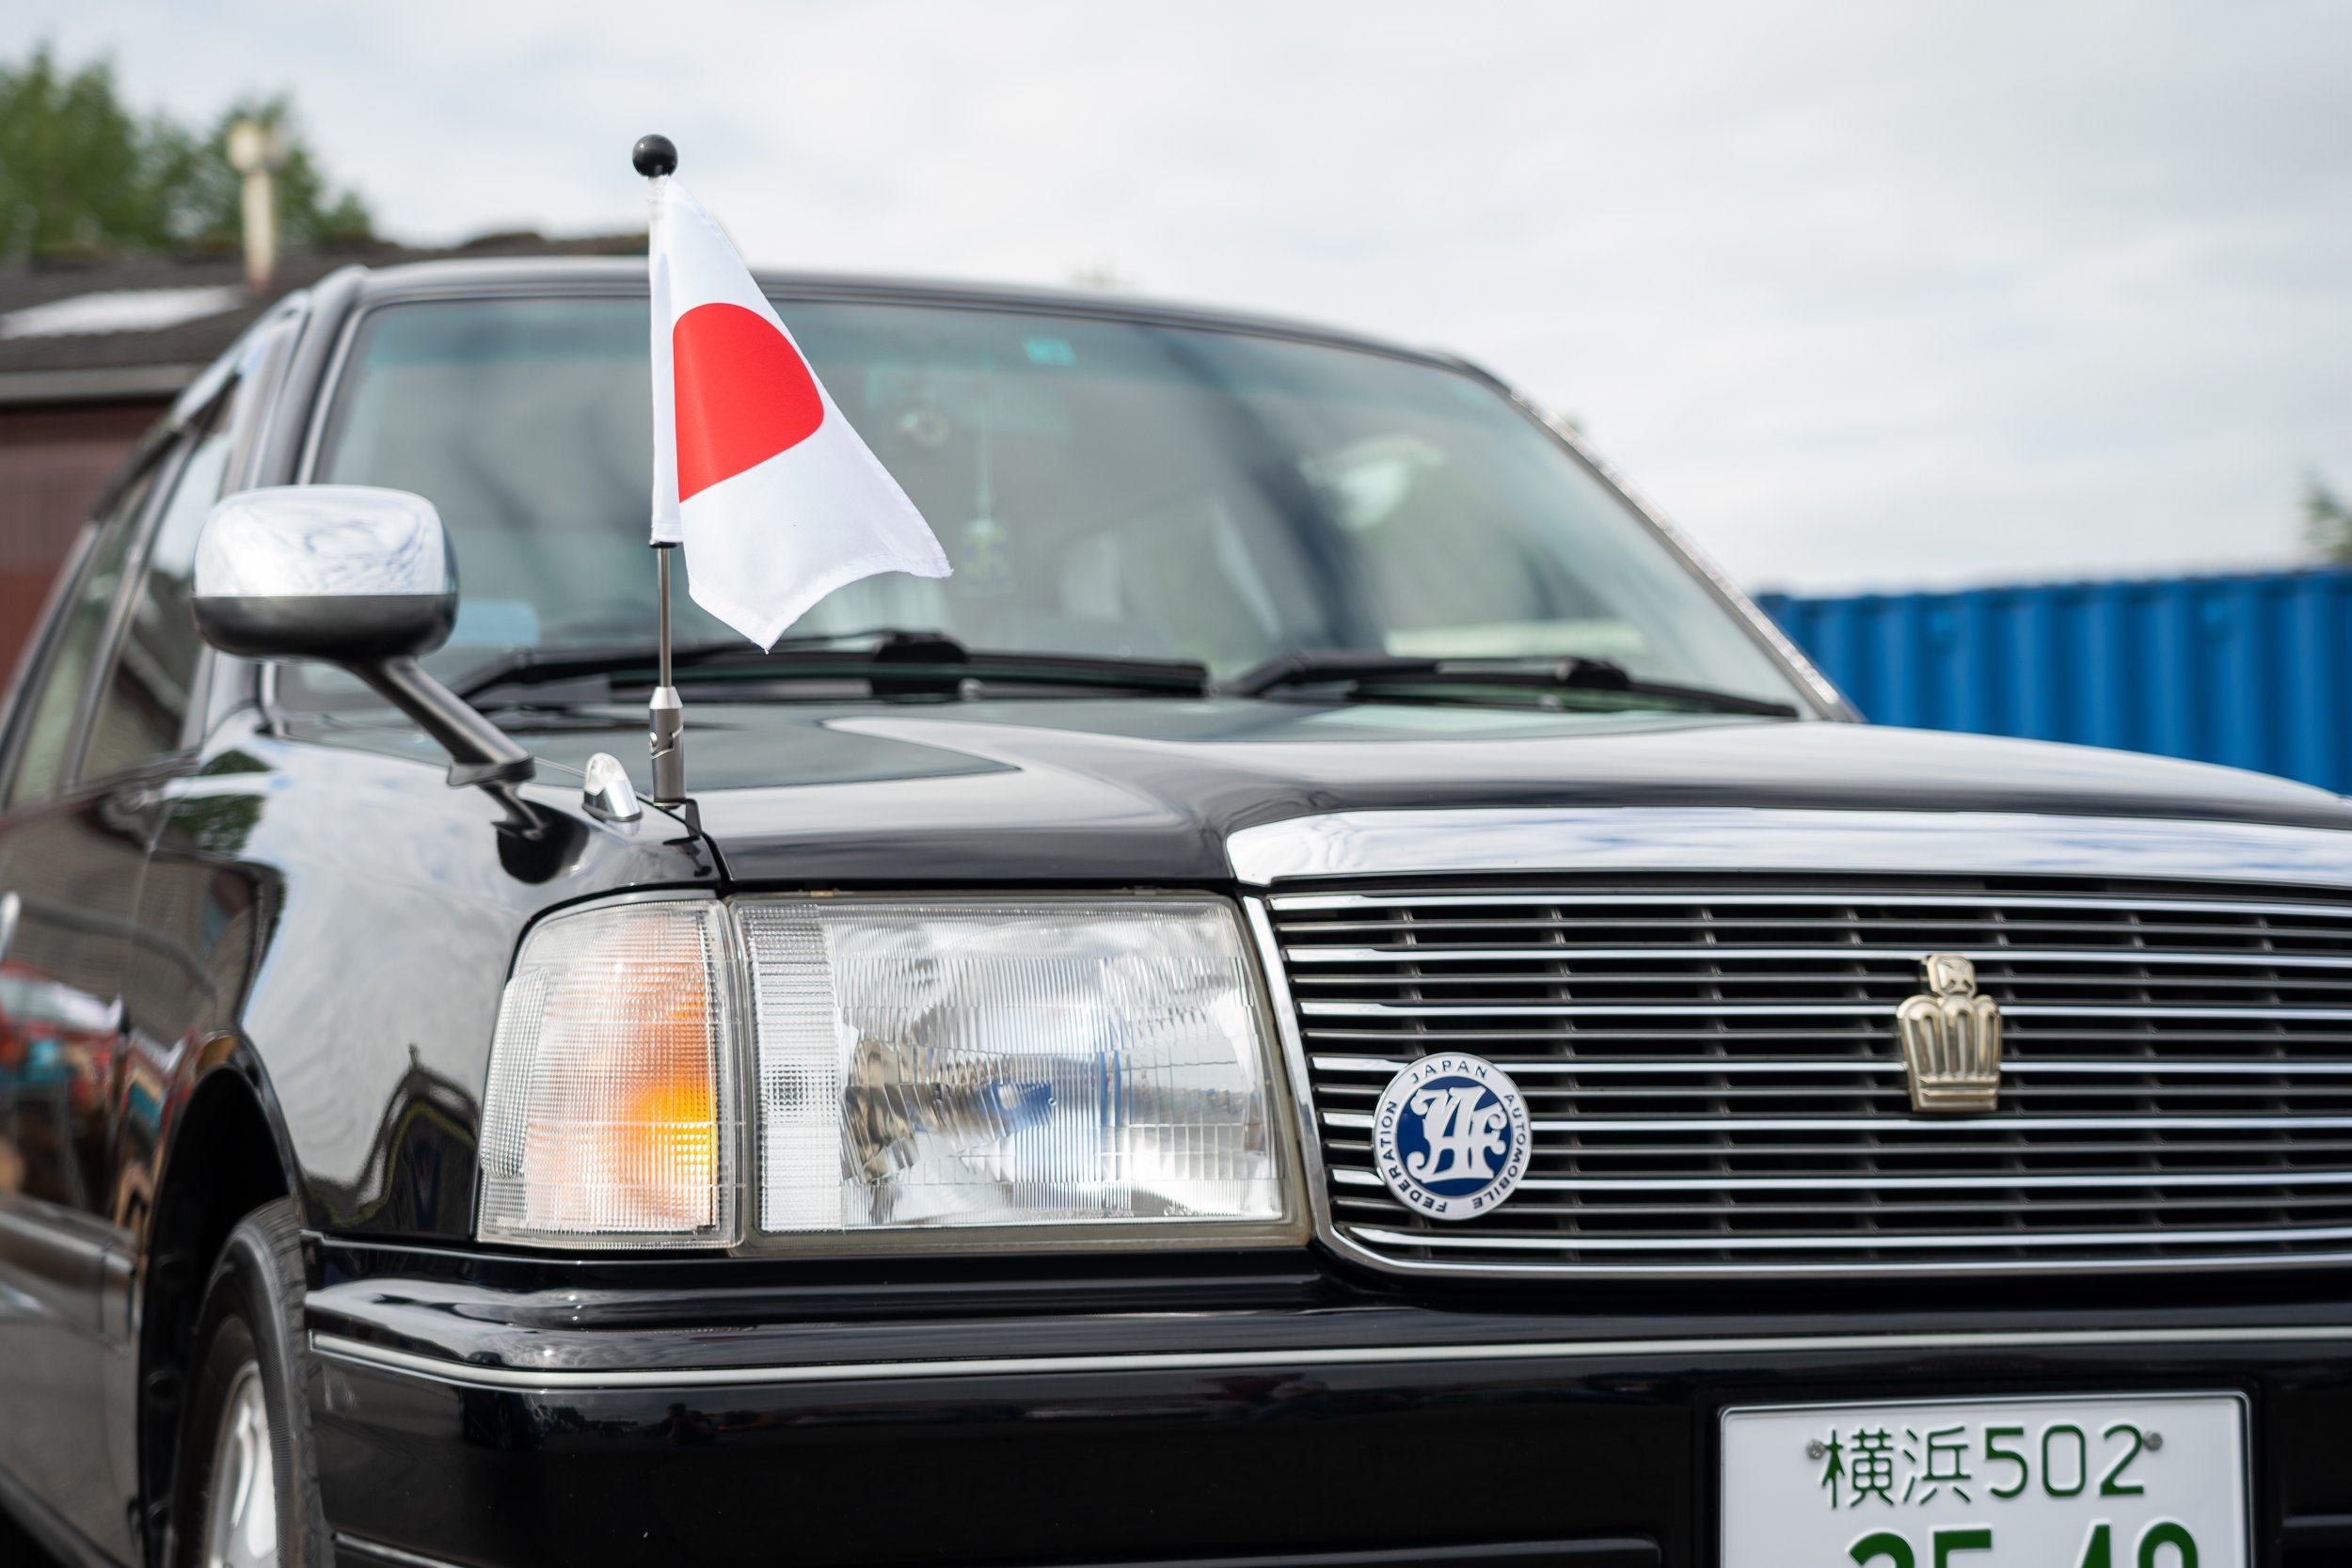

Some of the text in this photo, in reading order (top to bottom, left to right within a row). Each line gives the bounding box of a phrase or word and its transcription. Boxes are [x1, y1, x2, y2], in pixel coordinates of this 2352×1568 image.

[1379, 1059, 1526, 1213] JAPAN AUTOMOBILE FEDERATION
